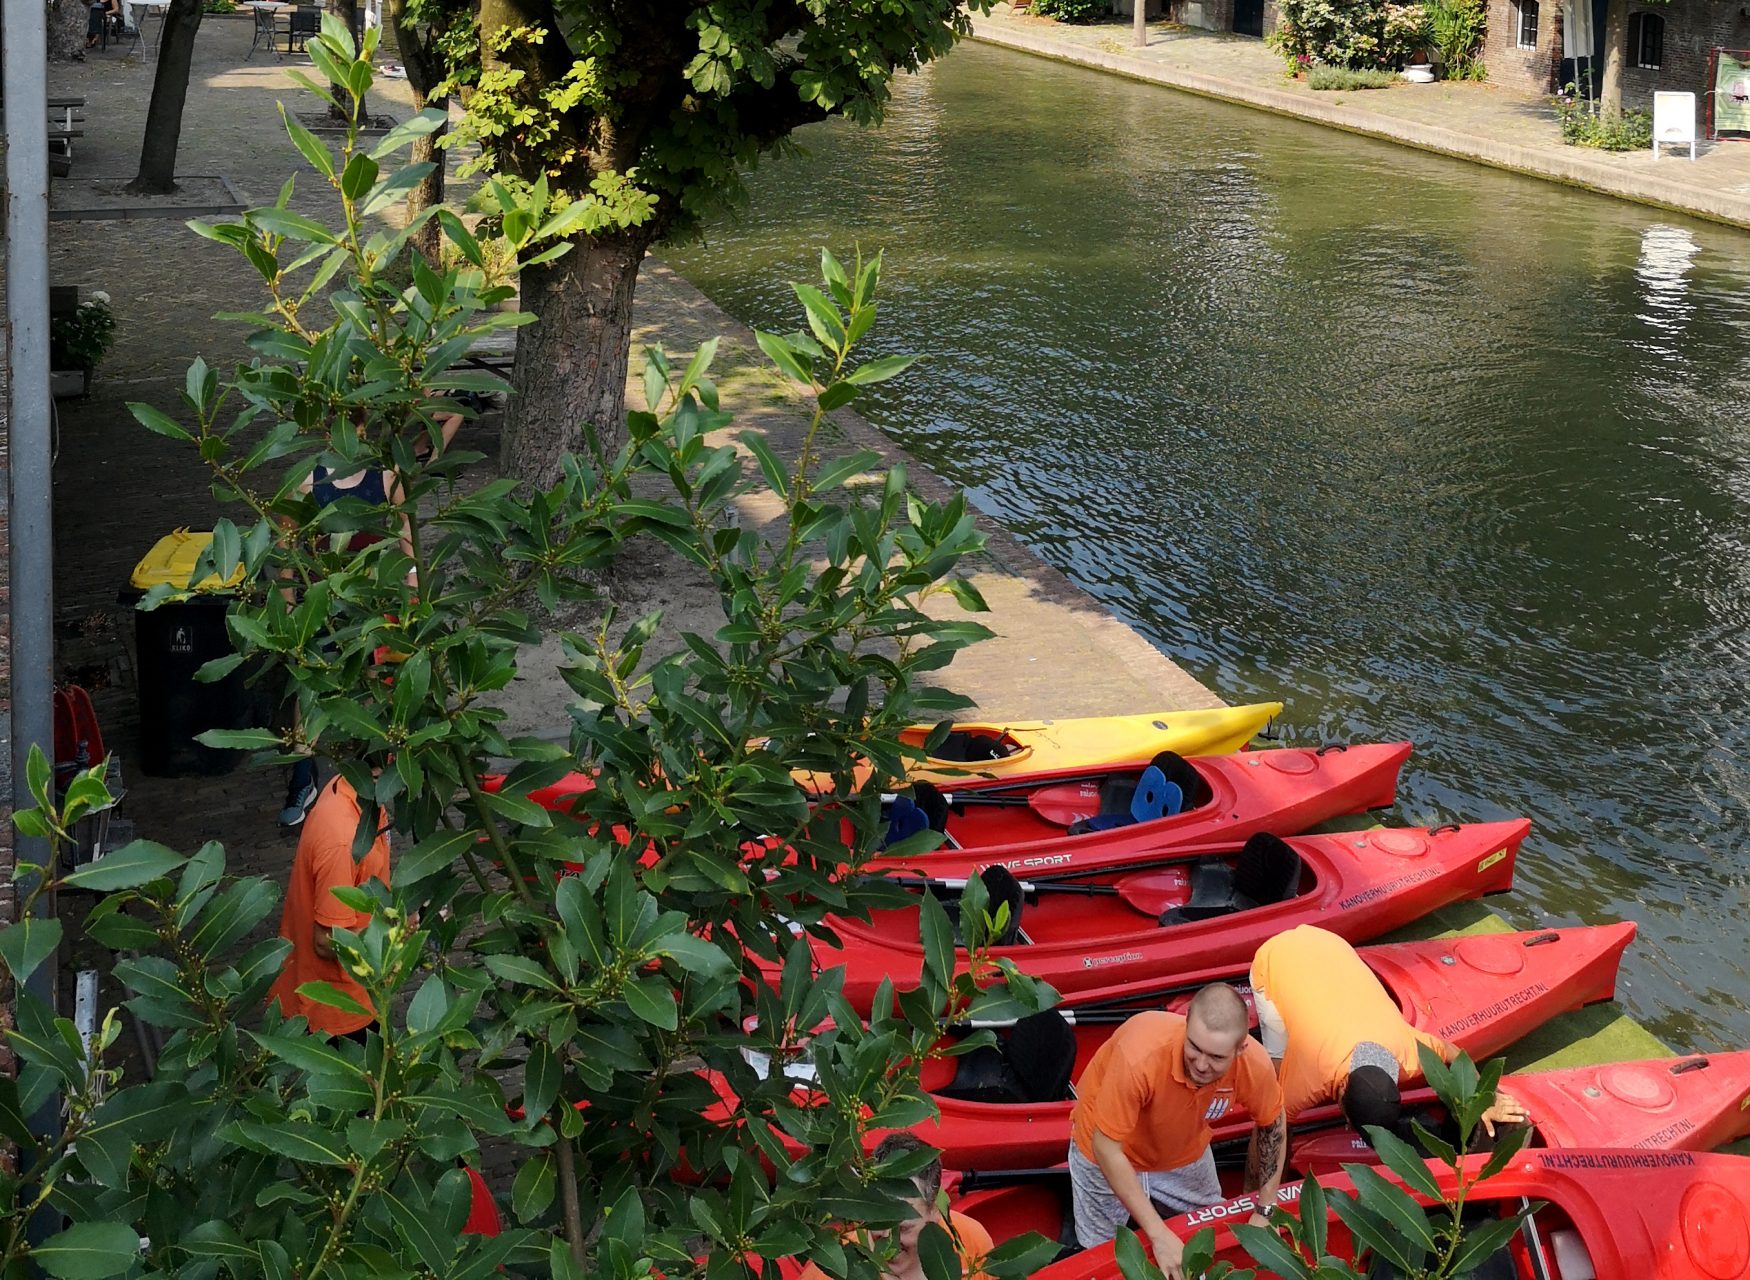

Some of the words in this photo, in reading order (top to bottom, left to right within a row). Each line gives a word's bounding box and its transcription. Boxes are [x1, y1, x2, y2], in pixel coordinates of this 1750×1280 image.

[1023, 853, 1072, 867] SPORT
[1338, 865, 1441, 911] KANOVERHUURUTRECHT.NL
[1438, 982, 1549, 1039] KANOVERHUURUTRECHT.NL
[1537, 1152, 1695, 1169] KANOVERHUURUTRECHT.NL
[1187, 1197, 1256, 1226] SPORT
